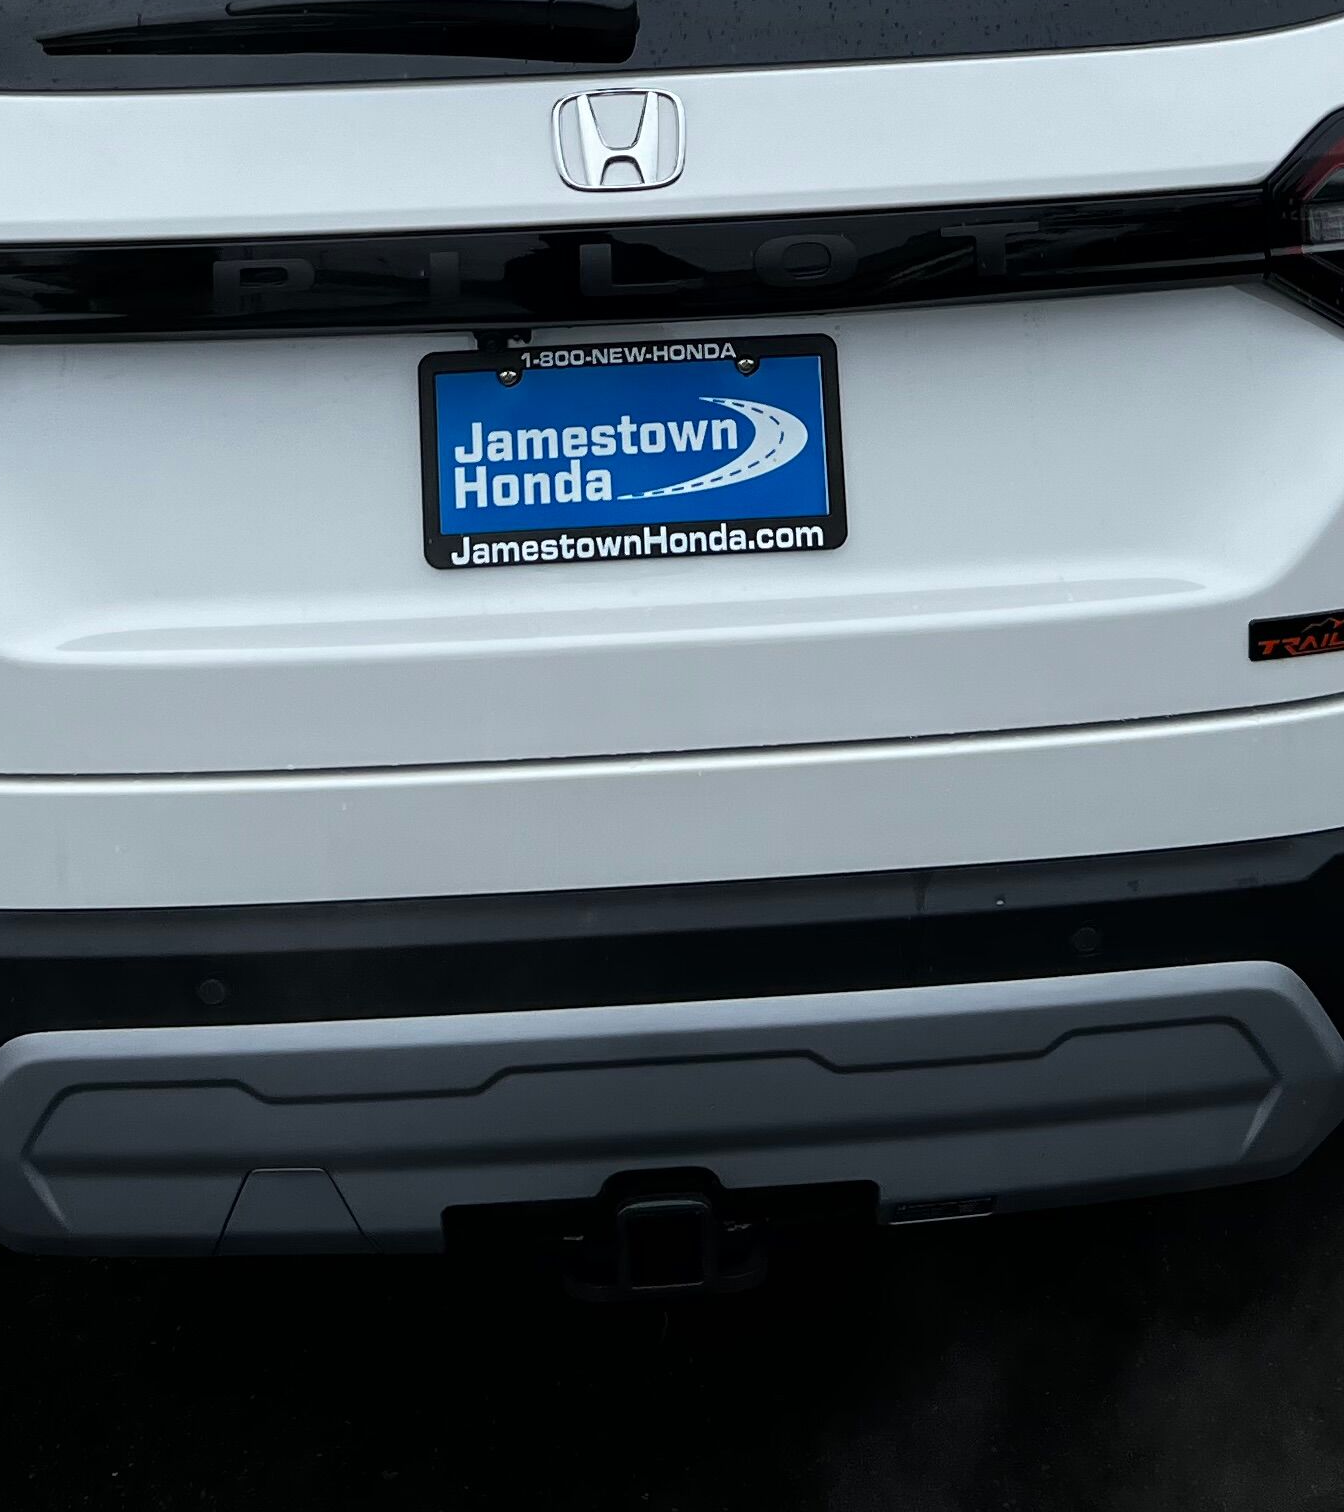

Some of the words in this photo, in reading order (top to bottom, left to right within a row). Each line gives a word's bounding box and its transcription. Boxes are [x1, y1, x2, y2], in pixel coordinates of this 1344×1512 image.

[212, 220, 1041, 314] PILOT
[520, 342, 737, 368] 1-800-NEW-HONDA
[454, 415, 739, 464] Jamestown
[454, 459, 613, 510] Honda
[450, 522, 825, 566] JamestownHonda.com
